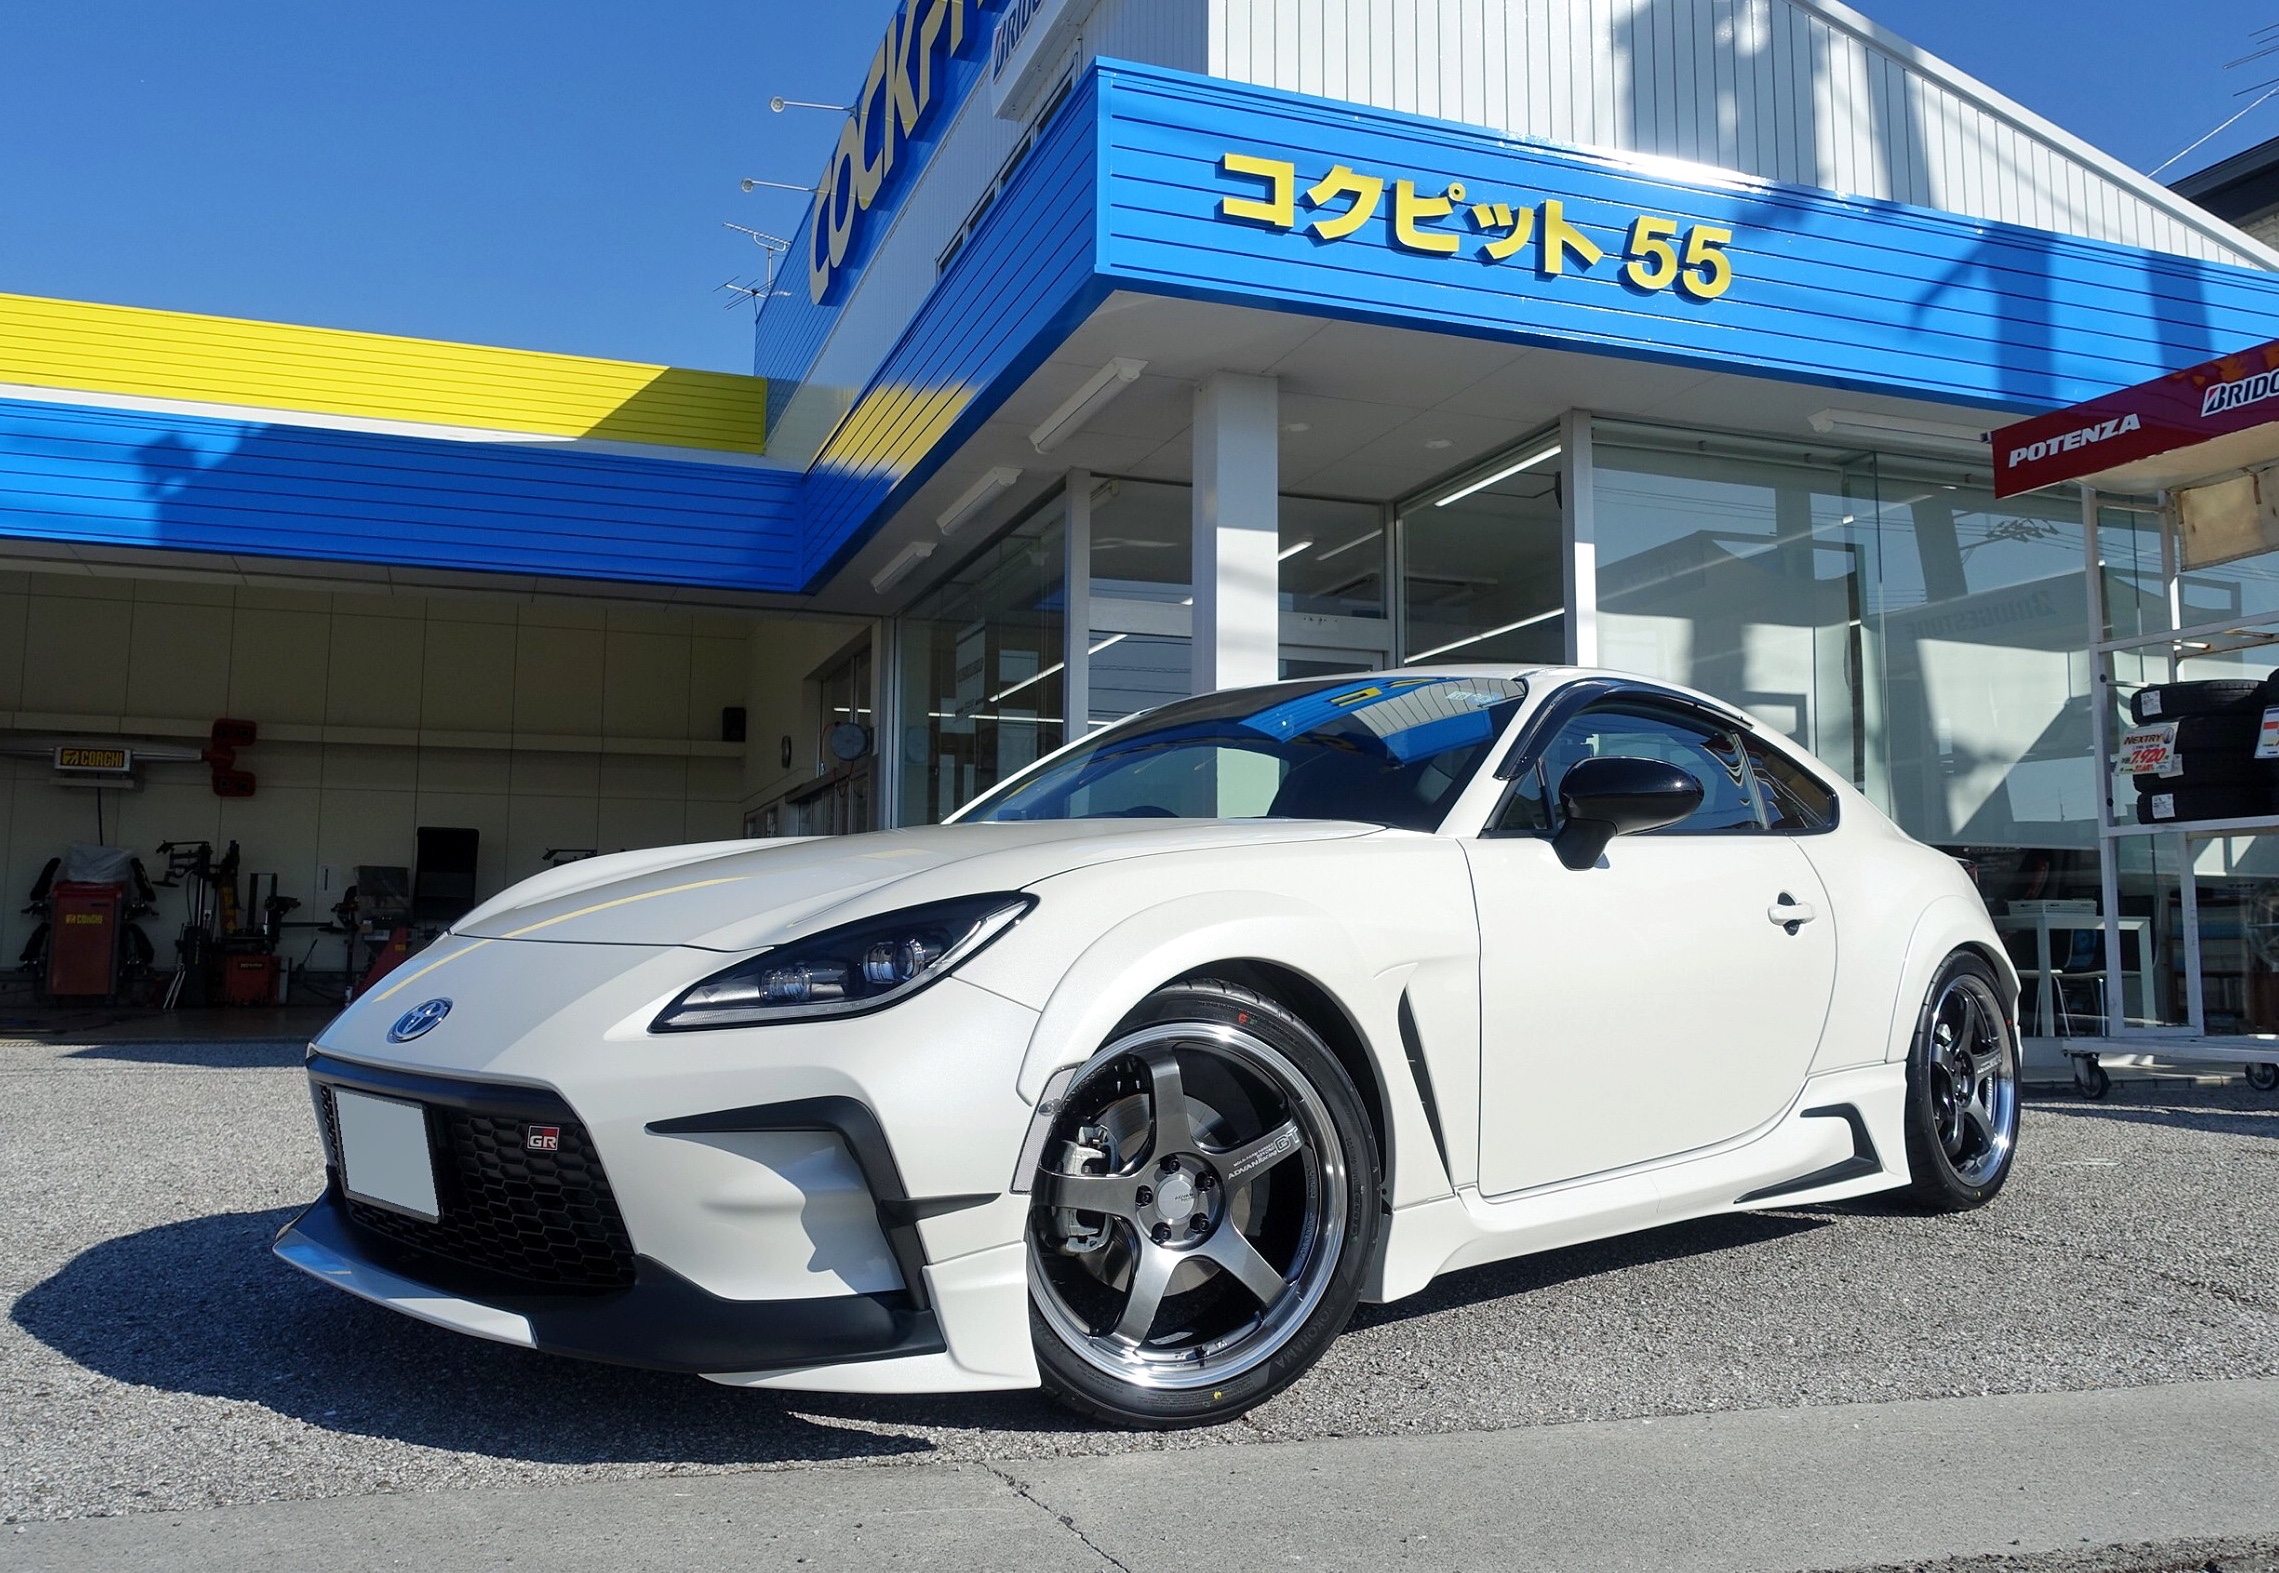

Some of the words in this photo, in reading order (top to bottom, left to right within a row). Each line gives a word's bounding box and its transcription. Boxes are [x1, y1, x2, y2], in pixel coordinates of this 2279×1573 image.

[1222, 153, 1603, 275] コクピット
[1627, 215, 1733, 299] 55
[2008, 413, 2141, 468] POTENZA
[2124, 734, 2164, 745] NEXTRY
[80, 750, 123, 767] CORGHI
[529, 1135, 557, 1148] GR
[1273, 1125, 1300, 1153] GT
[1227, 1159, 1259, 1180] ADVAN
